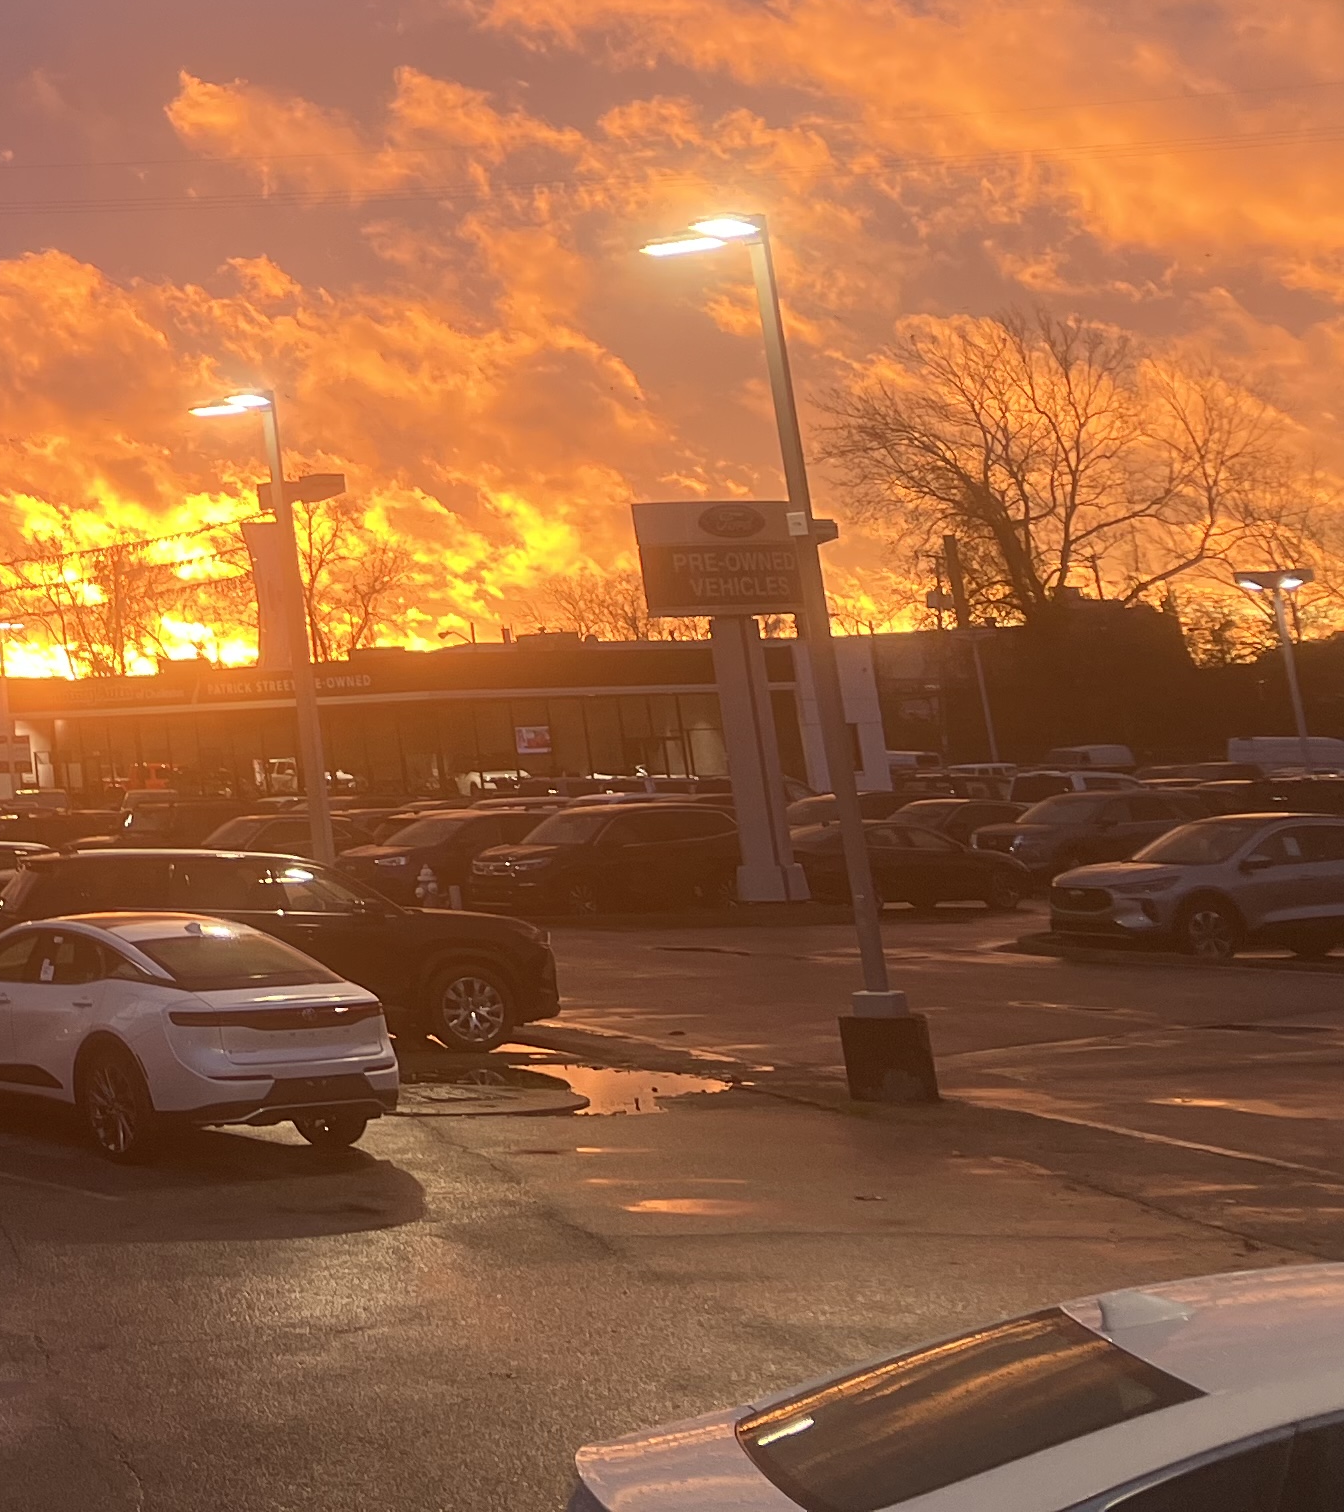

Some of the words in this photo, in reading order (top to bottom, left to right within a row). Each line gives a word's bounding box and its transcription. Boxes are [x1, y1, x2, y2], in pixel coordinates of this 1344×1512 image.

[672, 551, 794, 572] PRE-OWNED
[689, 576, 790, 597] VEHICLES
[208, 681, 250, 696] PATRICK
